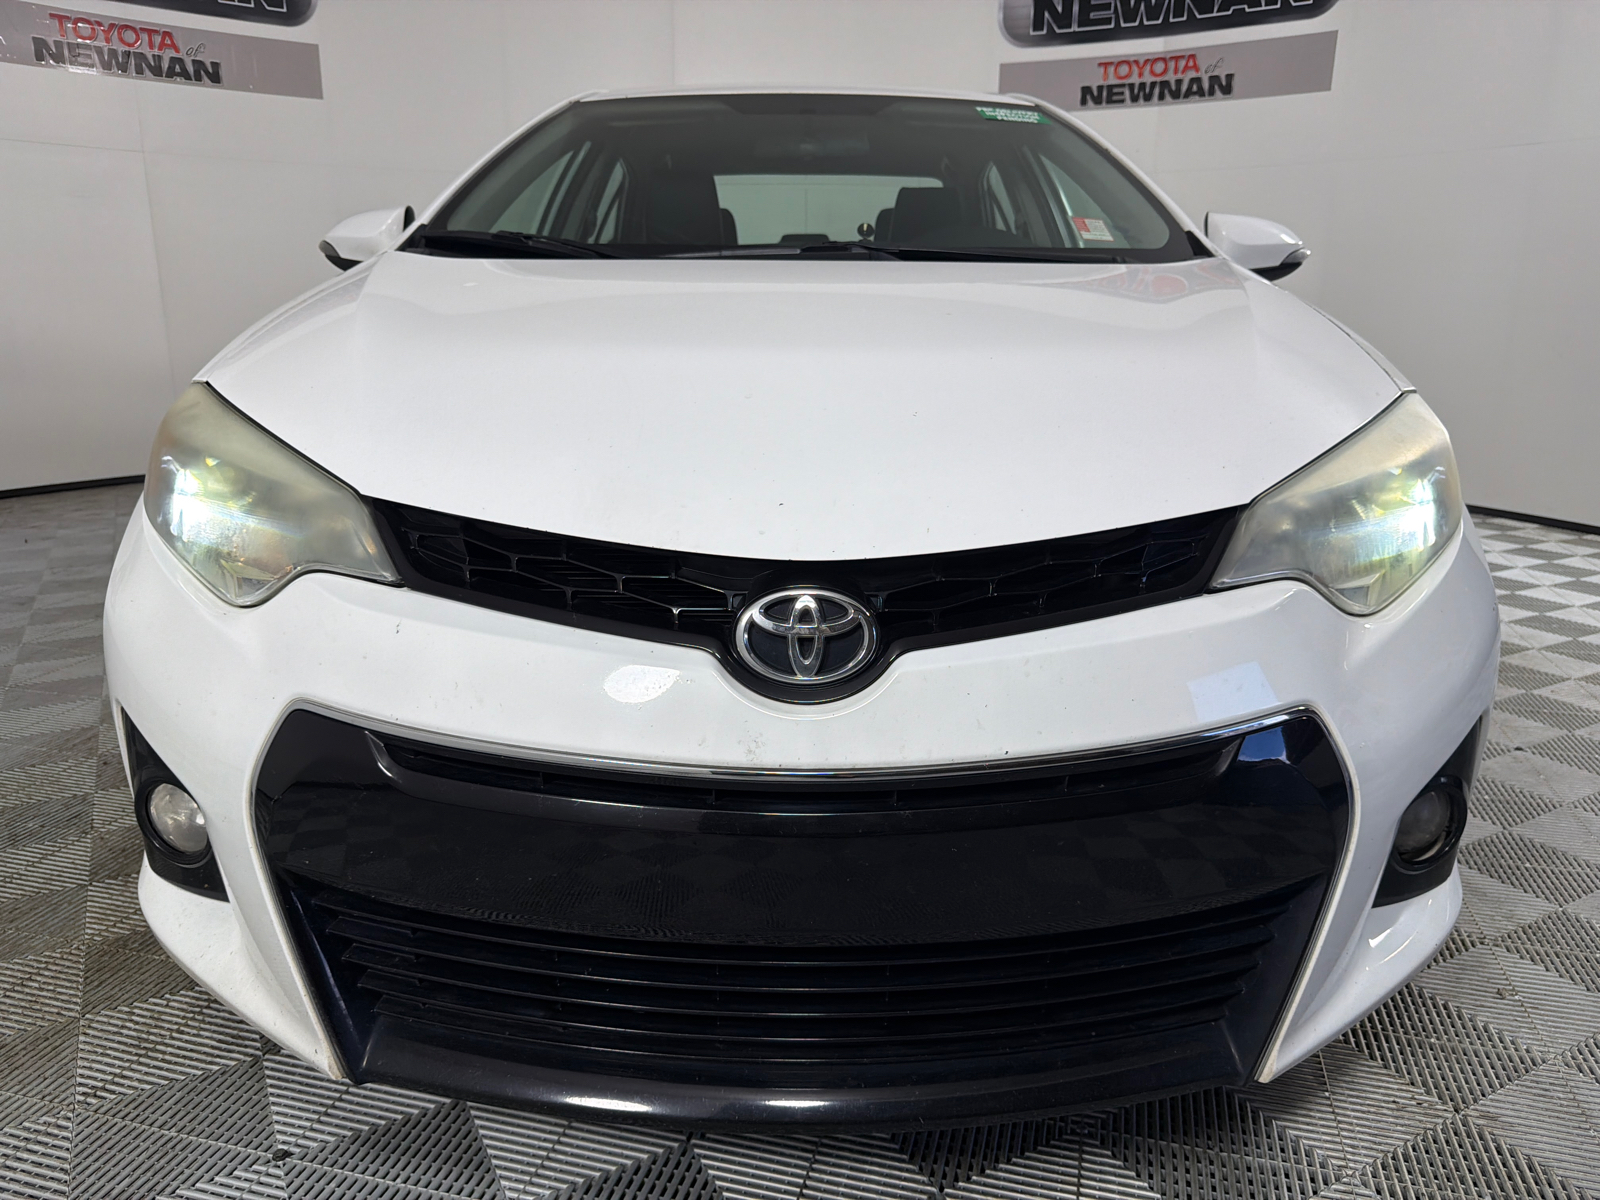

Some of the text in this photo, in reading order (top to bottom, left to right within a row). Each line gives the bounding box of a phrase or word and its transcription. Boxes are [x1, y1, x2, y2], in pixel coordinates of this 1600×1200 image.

[48, 12, 206, 58] TOYOTA of
[31, 36, 221, 84] NEWNAN
[1098, 53, 1224, 82] TOYOTA of
[1079, 73, 1235, 107] NEWNAN
